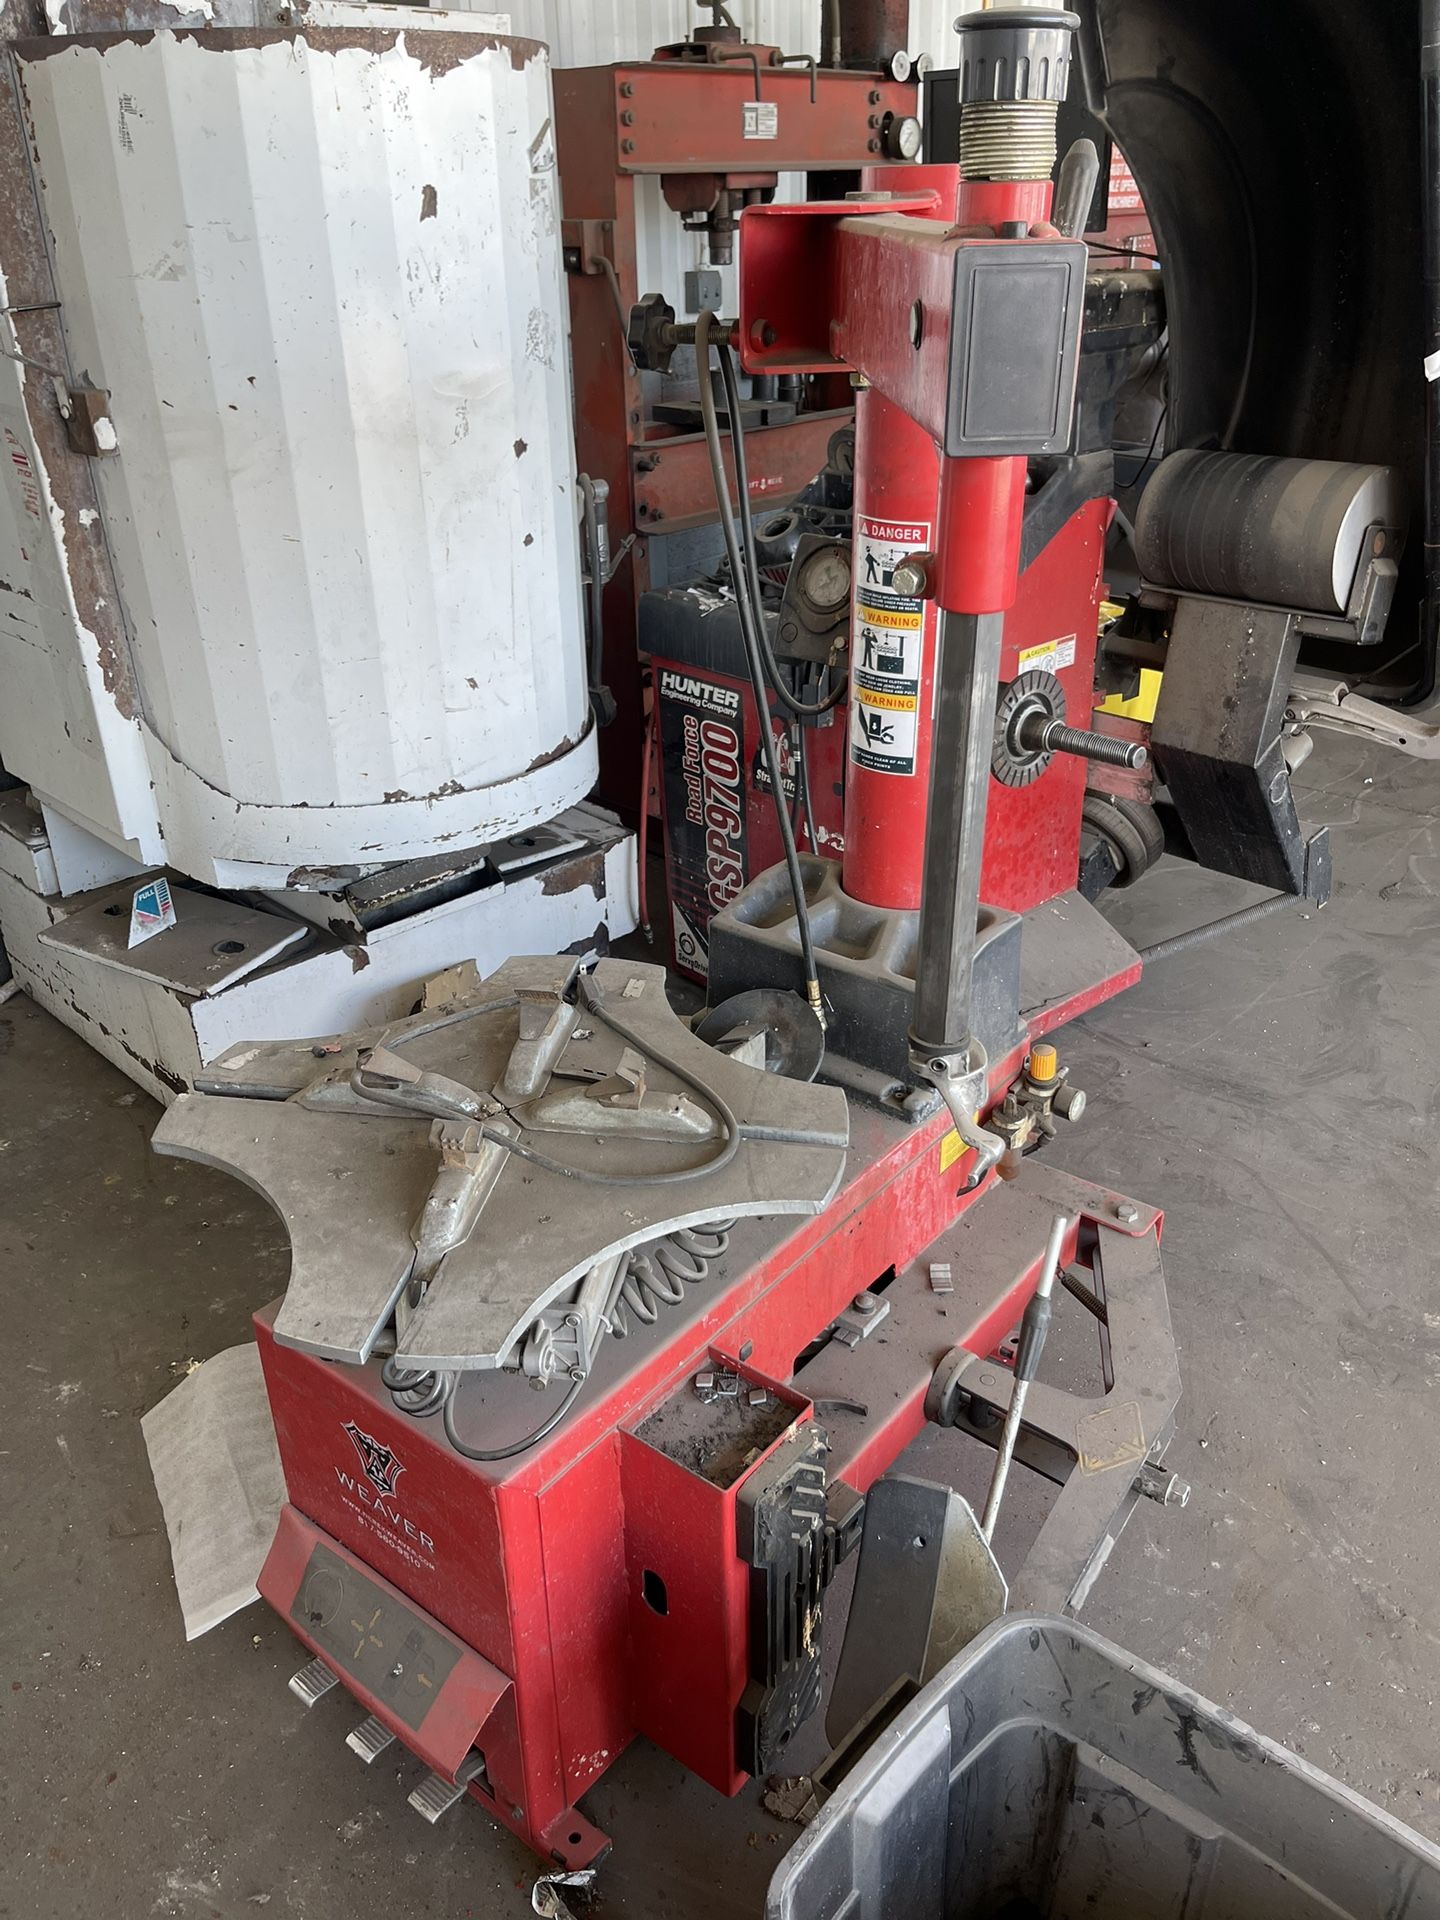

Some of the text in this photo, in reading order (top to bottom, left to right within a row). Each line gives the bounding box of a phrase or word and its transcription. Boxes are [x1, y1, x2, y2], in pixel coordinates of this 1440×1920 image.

[871, 524, 922, 541] DANGER
[867, 612, 919, 628] WARNING
[660, 686, 738, 718] Engineering Company
[661, 672, 739, 709] HUNTER
[864, 693, 914, 709] WARNING
[682, 714, 703, 826] Road Force
[138, 888, 155, 902] FULL
[334, 1465, 435, 1553] WEAVER
